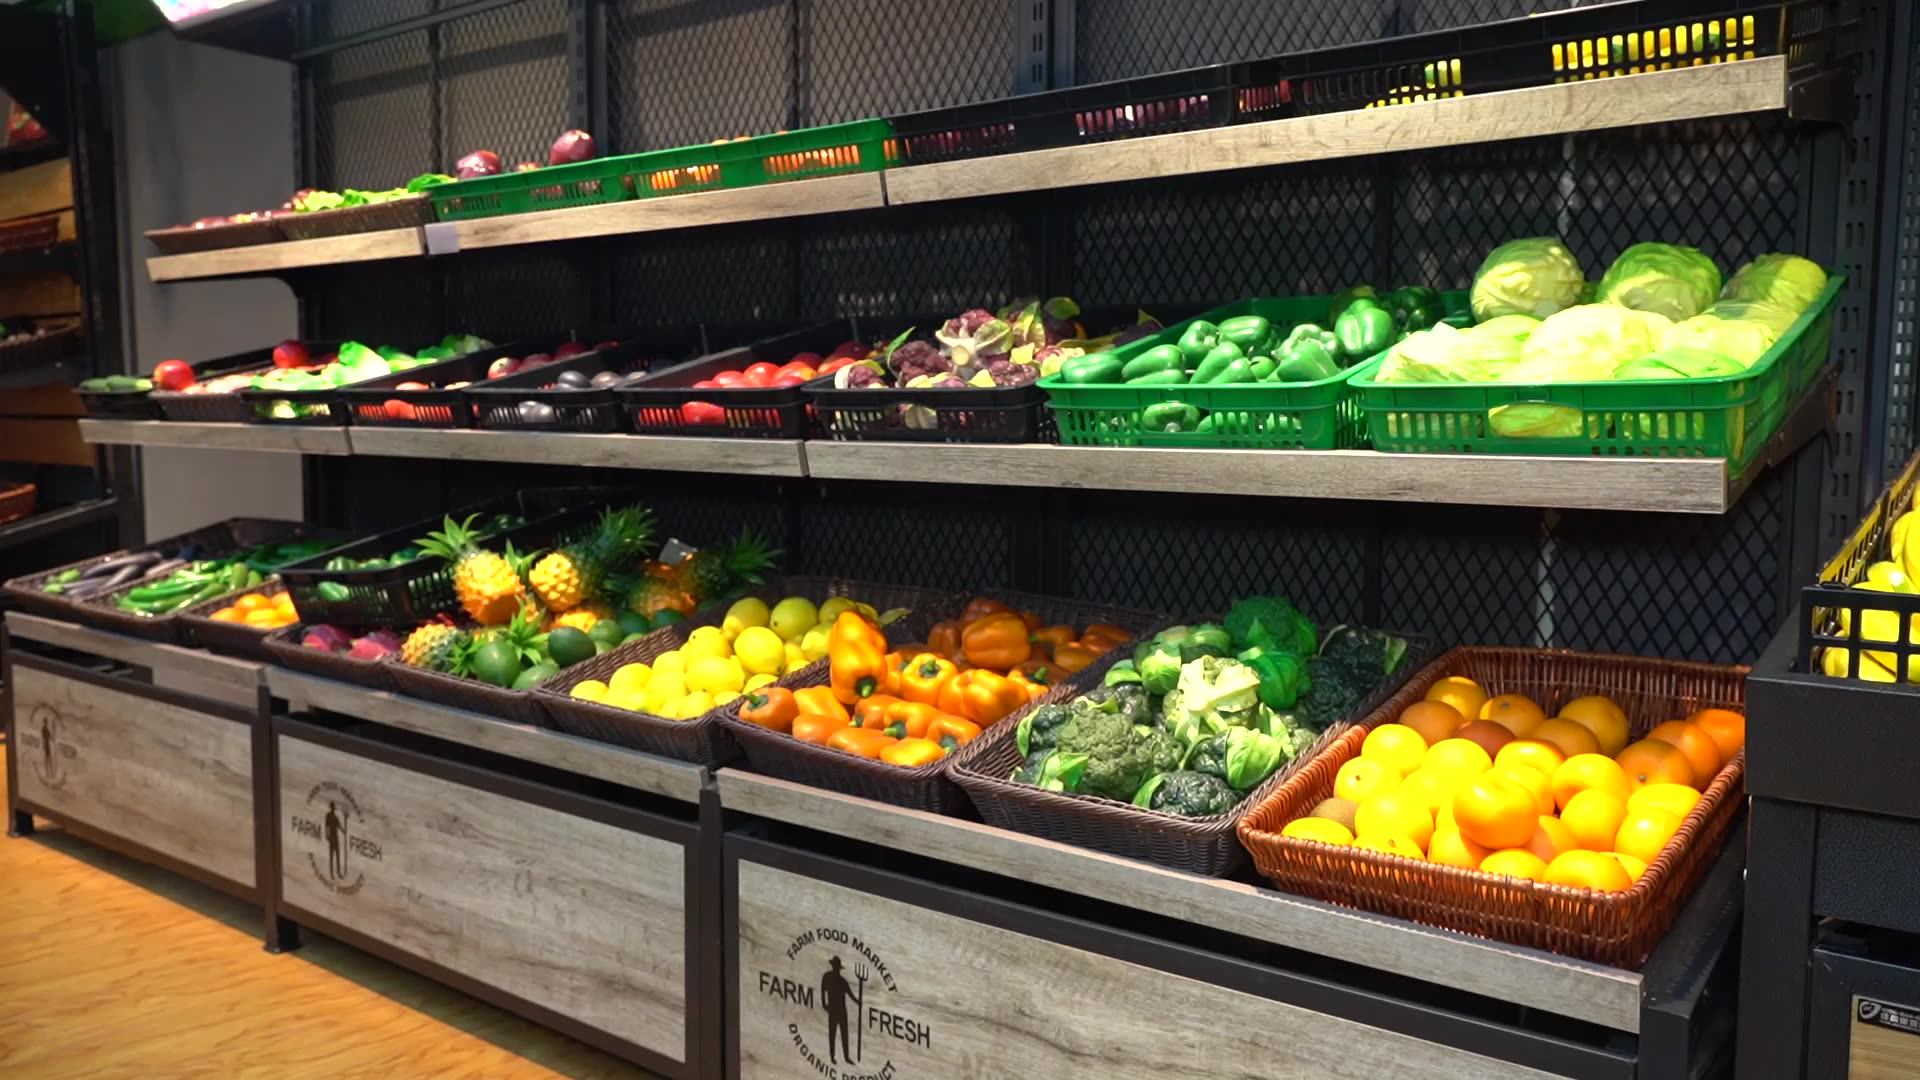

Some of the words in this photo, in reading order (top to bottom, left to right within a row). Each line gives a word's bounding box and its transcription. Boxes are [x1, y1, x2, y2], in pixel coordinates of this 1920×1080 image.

[787, 931, 815, 960] FARM
[816, 928, 849, 944] FOOD
[852, 937, 898, 993] MARKET
[759, 971, 814, 1009] FARM
[868, 1007, 930, 1048] FRESH
[788, 1023, 837, 1080] ORGANIC
